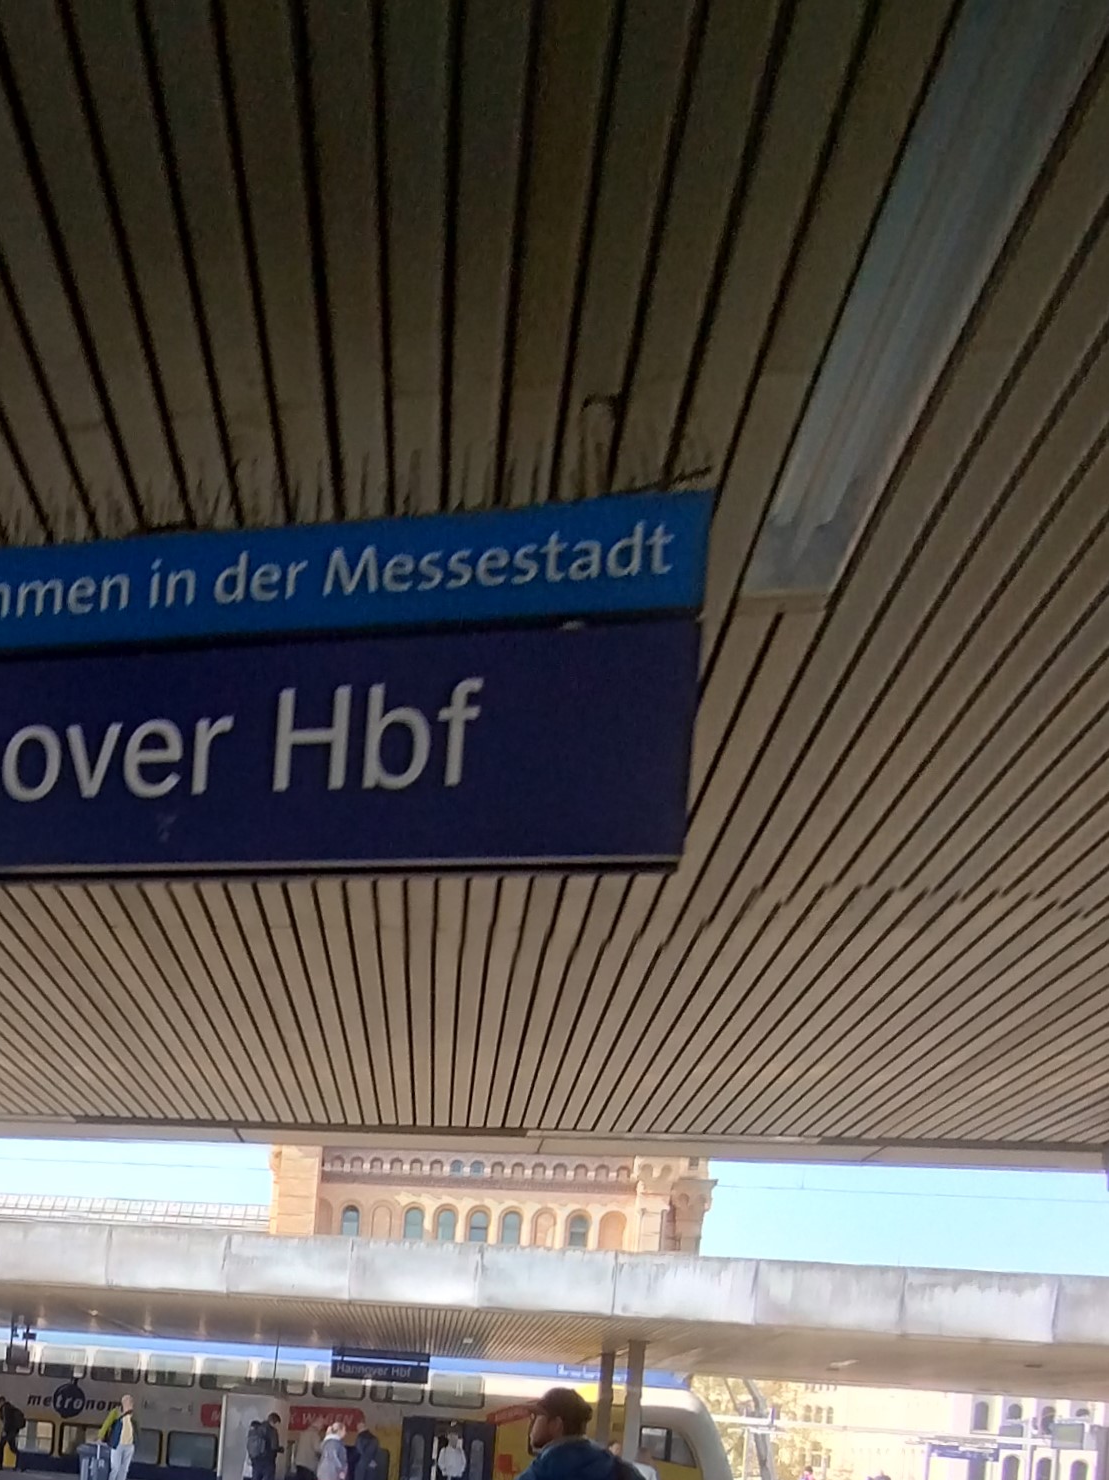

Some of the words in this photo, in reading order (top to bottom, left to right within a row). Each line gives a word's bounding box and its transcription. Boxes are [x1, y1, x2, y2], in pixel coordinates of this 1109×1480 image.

[149, 558, 196, 608] in
[214, 550, 308, 604] der
[323, 520, 675, 597] Messestadt
[272, 677, 485, 793] Hbf
[336, 1362, 389, 1376] Hannover
[391, 1365, 412, 1378] Hbf
[27, 1394, 125, 1412] metronom
